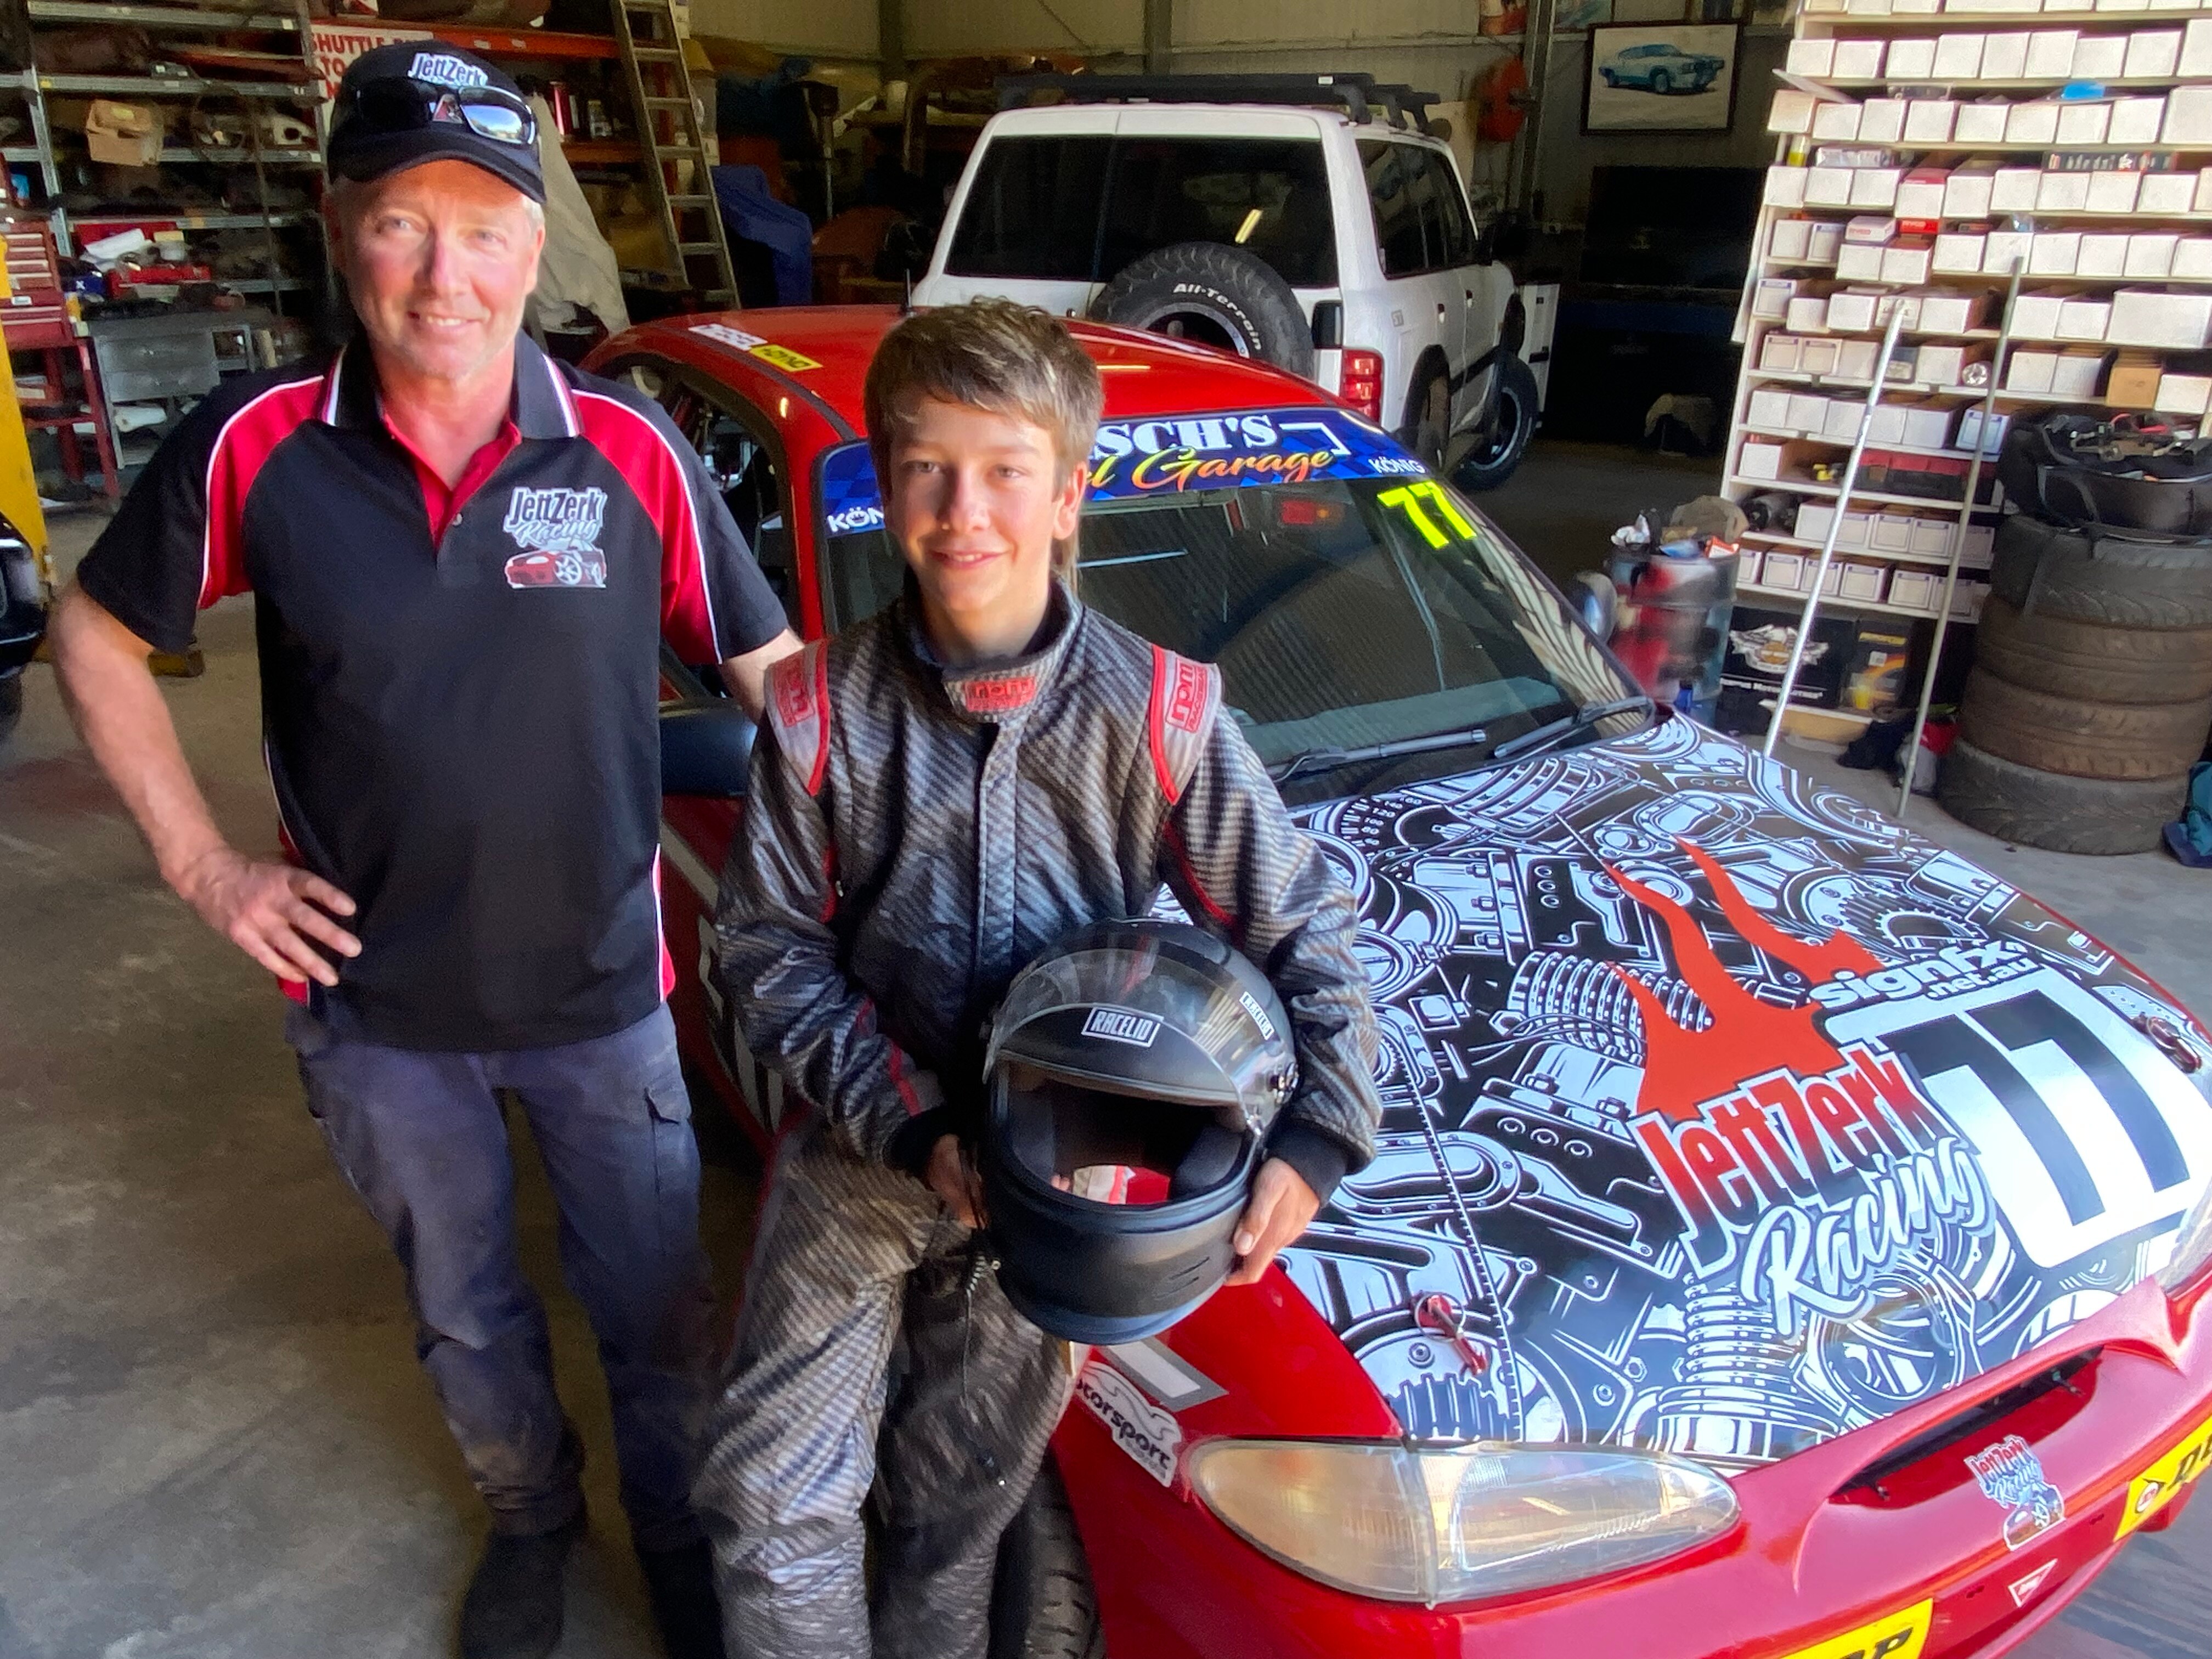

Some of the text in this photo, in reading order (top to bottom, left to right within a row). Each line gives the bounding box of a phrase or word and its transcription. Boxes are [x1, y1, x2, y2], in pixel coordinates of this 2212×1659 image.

[320, 55, 345, 77] TO
[413, 55, 483, 86] JettZerk
[1131, 445, 1334, 492] Garage
[1368, 456, 1425, 473] KÖNIG
[509, 491, 600, 526] JettZerk
[1376, 481, 1477, 549] 77
[515, 518, 597, 548] Racing
[1809, 940, 2026, 1008] signfx
[1927, 957, 2039, 998] .net.au
[1090, 1011, 1153, 1041] RACELID
[1876, 989, 2190, 1227] 77
[1635, 1047, 1939, 1267] JettZerk
[1740, 1136, 1987, 1337] Racing
[1970, 1439, 2031, 1491] JettZerk
